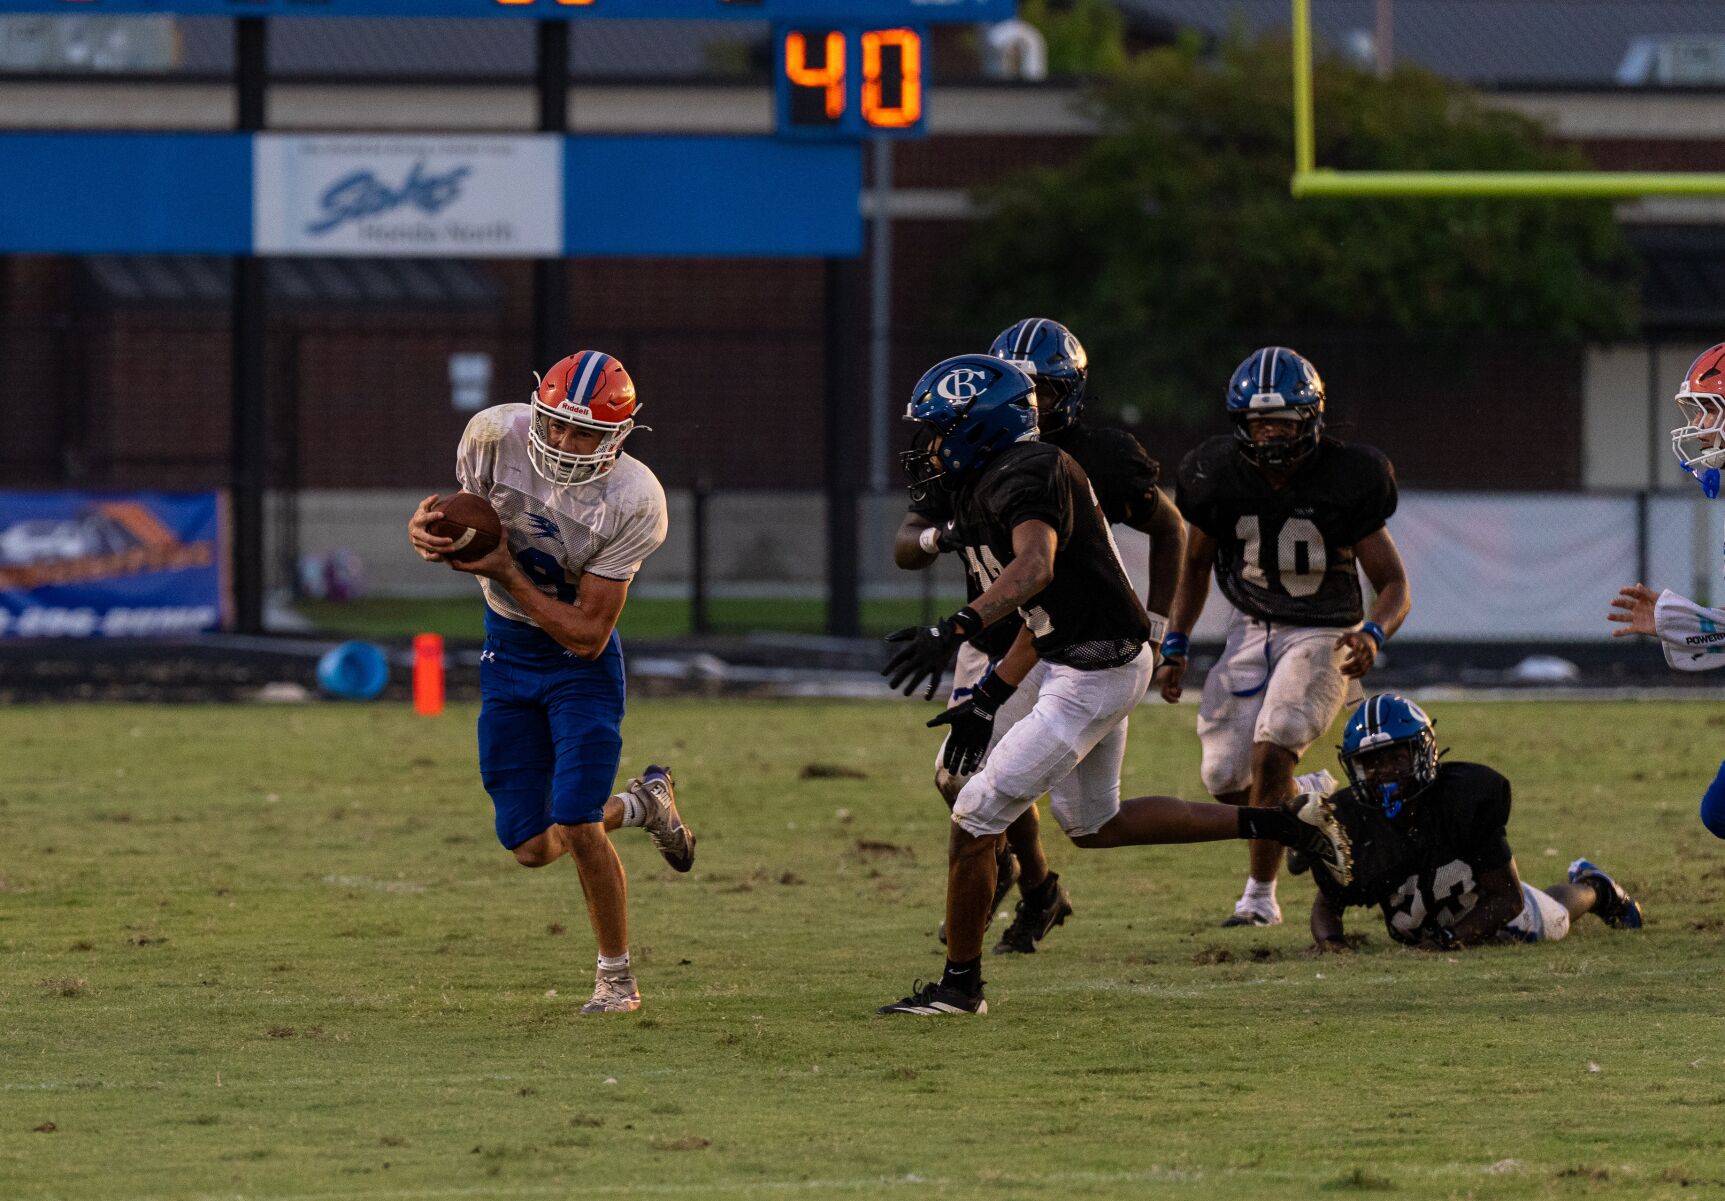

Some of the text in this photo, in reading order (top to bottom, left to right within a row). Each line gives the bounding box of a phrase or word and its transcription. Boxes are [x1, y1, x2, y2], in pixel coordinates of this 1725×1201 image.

[785, 28, 921, 128] 40
[562, 402, 589, 416] Riddell
[1235, 515, 1327, 598] 10
[650, 784, 673, 809] NIKE
